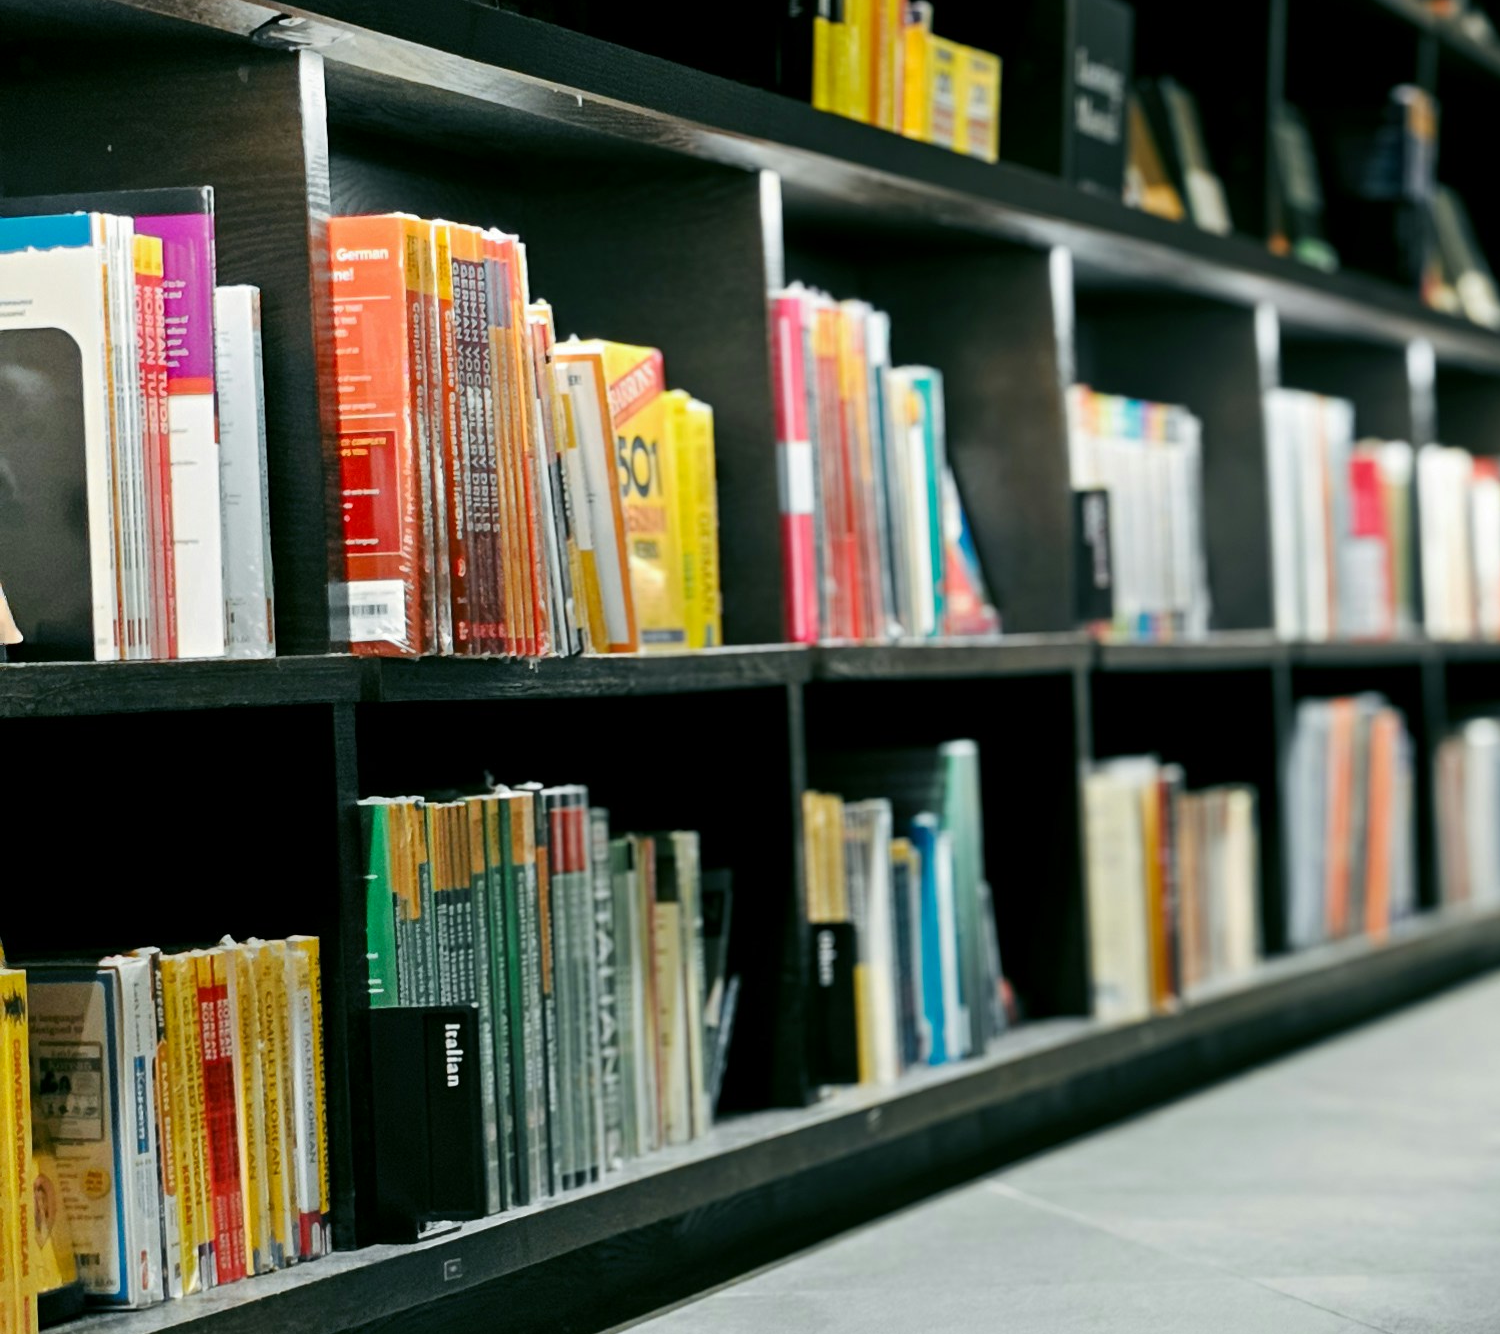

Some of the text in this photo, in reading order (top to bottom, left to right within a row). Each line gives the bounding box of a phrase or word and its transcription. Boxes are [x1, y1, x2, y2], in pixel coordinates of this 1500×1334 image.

[336, 247, 390, 262] German
[453, 261, 463, 340] GERMAN
[144, 286, 159, 434] KOREAN TUTOR
[155, 287, 169, 435] KOREAN TUTOR
[444, 309, 457, 388] Complete
[461, 264, 472, 342] GERMAN
[472, 472, 483, 532] DRILLS
[468, 265, 480, 343] GERMAN
[480, 472, 492, 532] DRILLS
[477, 266, 489, 344] GERMAN
[489, 473, 501, 534] DRILLS
[617, 435, 663, 497] 501
[480, 963, 491, 1018] Italian
[521, 954, 531, 1007] Italian
[201, 1001, 212, 1061] KOREAN
[265, 990, 278, 1093] COMPLETE
[445, 1023, 465, 1088] Italian
[302, 995, 318, 1165] GET TALKING KOREAN
[13, 1038, 30, 1278] CONVERSATIONAL KOREAN
[246, 1102, 257, 1181] KOREAN
[269, 1098, 281, 1176] KOREAN
[182, 1164, 193, 1226] KOREAN
